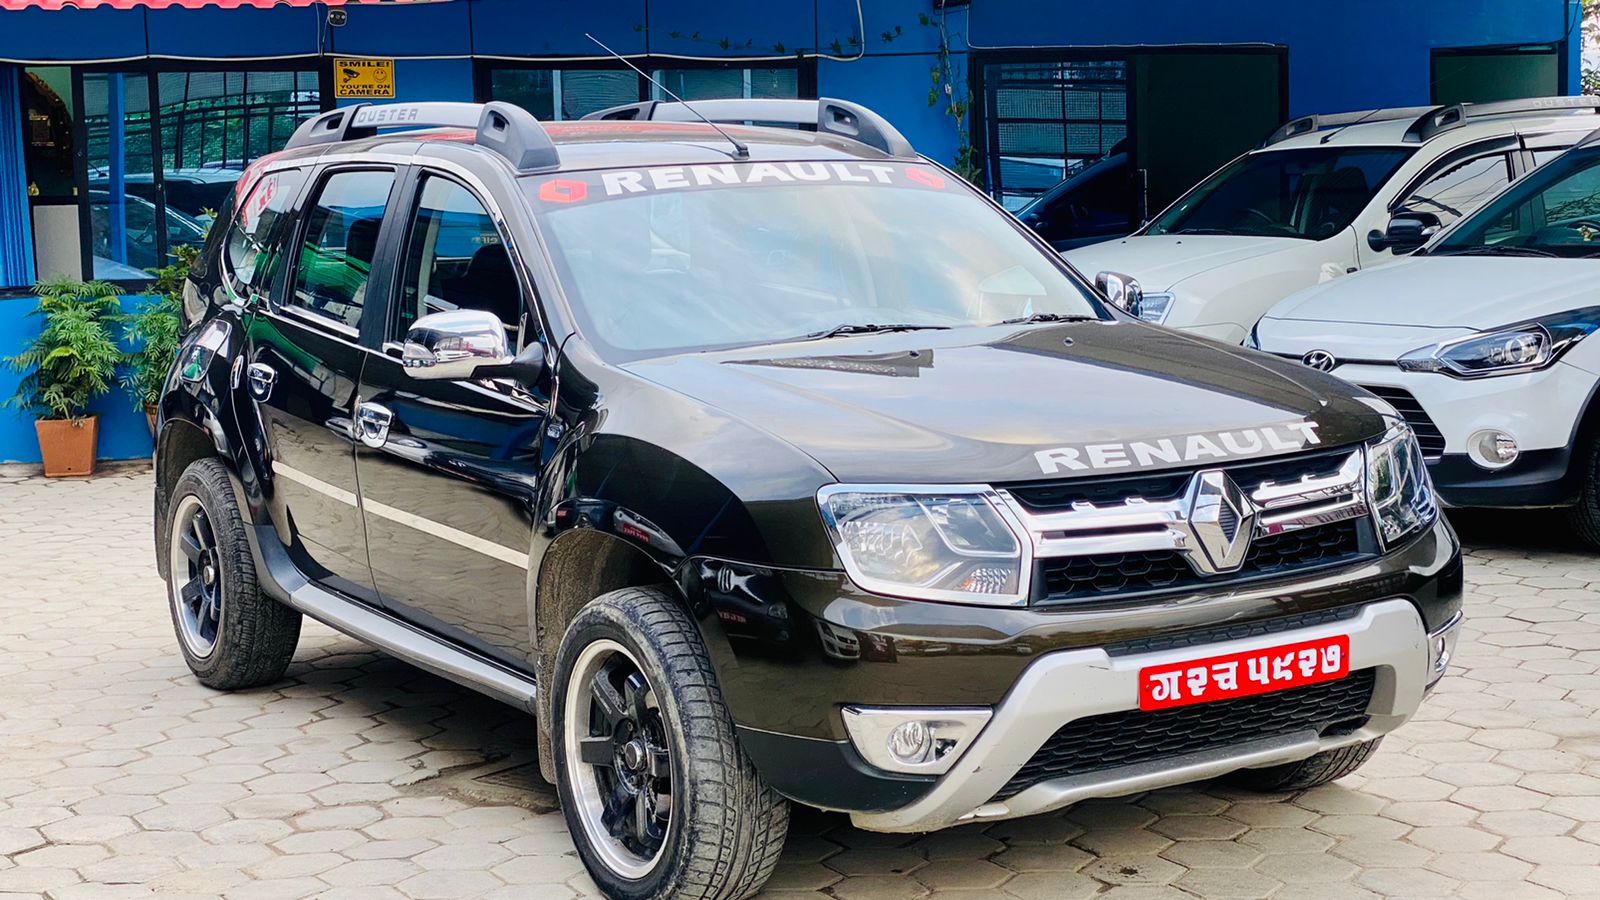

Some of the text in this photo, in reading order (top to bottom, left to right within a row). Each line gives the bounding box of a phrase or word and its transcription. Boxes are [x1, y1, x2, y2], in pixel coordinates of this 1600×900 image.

[358, 108, 418, 123] DUSTER
[601, 162, 894, 196] RENAULT
[1034, 421, 1320, 474] RENAULT
